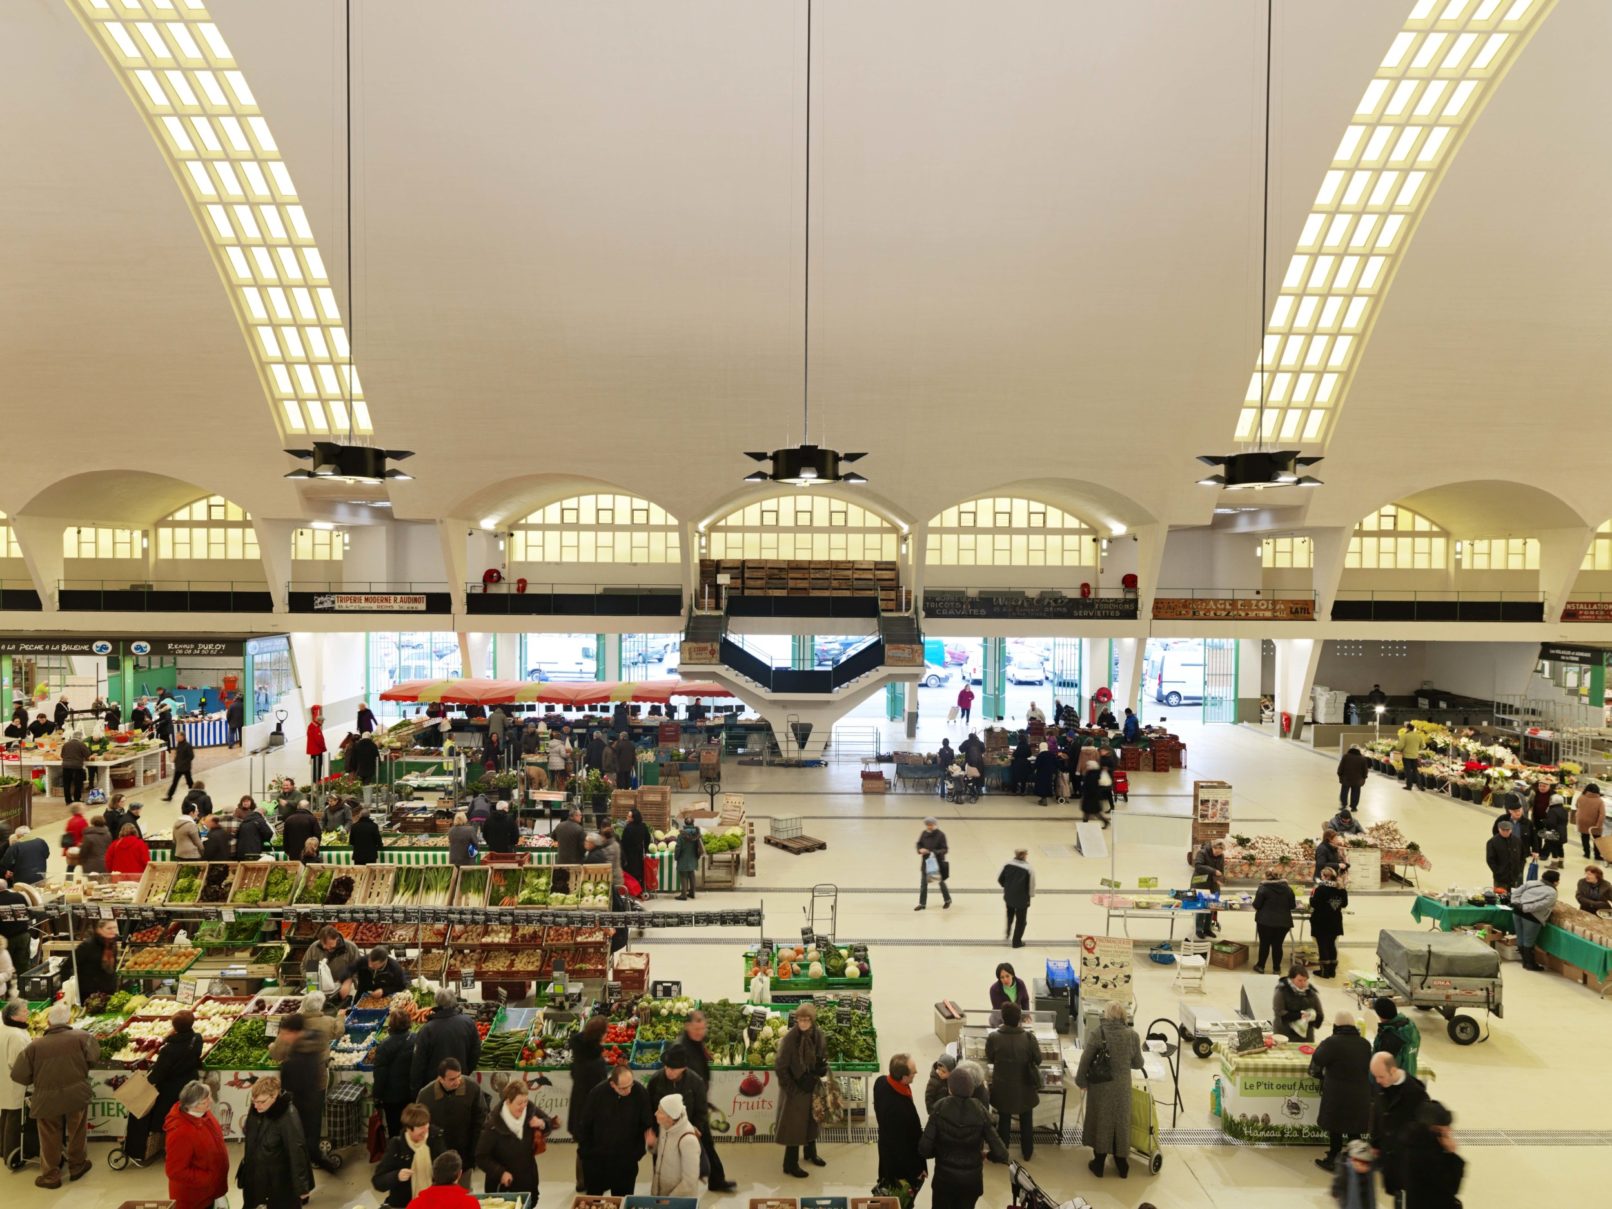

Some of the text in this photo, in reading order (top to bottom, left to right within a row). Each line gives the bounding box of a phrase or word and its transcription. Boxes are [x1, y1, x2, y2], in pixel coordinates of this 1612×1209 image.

[336, 596, 362, 604] TRIPERIE
[364, 596, 392, 604] MODERNE
[1244, 1081, 1255, 1090] Le
[1256, 1081, 1275, 1091] P'tit
[1276, 1081, 1296, 1091] oeuf
[728, 1095, 774, 1117] fruits
